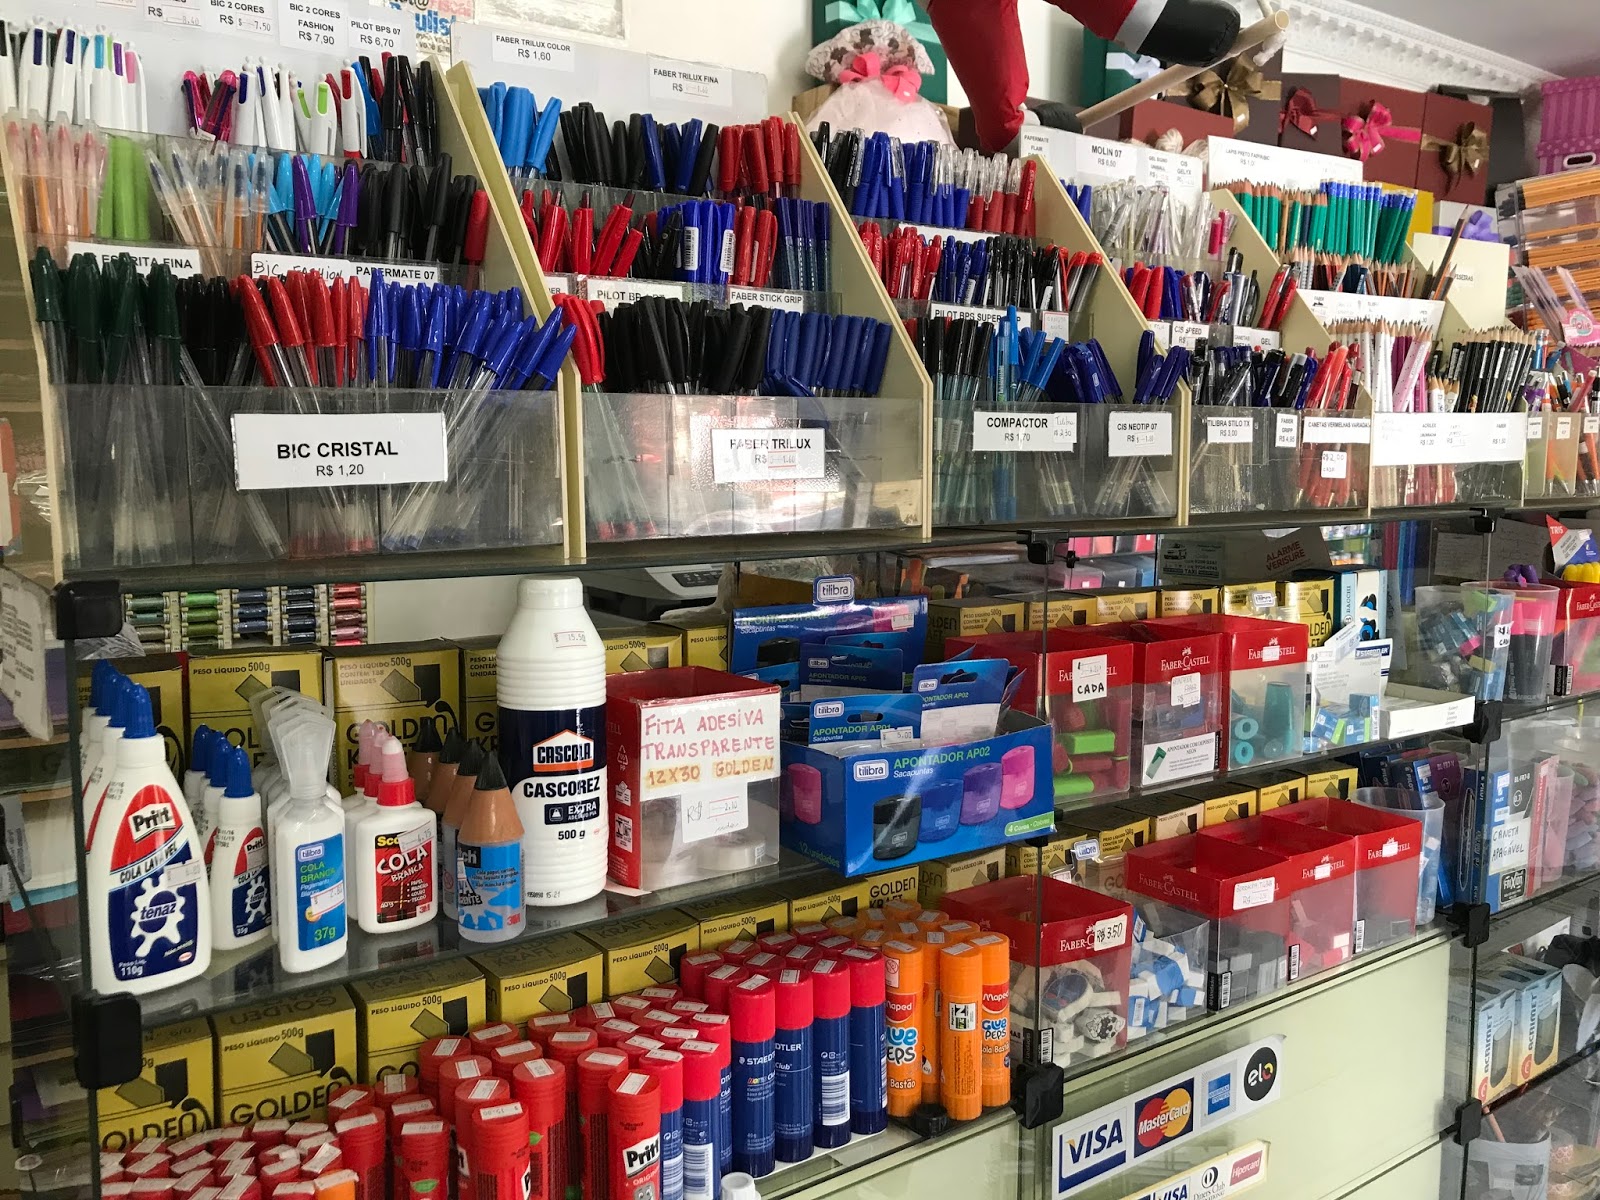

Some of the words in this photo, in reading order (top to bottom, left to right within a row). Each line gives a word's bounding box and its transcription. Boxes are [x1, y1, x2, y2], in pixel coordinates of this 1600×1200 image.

[210, 0, 225, 8] BIC
[227, 1, 233, 9] 2
[234, 2, 265, 14] CORES
[289, 3, 304, 12] BIC
[306, 6, 311, 14] 2
[312, 7, 341, 19] CORES
[219, 14, 234, 25] R$
[298, 20, 334, 32] FASHION
[351, 21, 373, 31] PILOT
[376, 24, 391, 34] BPS
[298, 31, 312, 41] R$
[360, 34, 373, 45] R$
[495, 35, 520, 45] FABER
[521, 39, 545, 48] TRILUX
[547, 43, 571, 52] COLOR
[517, 48, 530, 60] R$
[653, 68, 677, 79] FABER
[678, 71, 702, 82] TRILUX
[704, 75, 719, 84] FINA
[672, 83, 683, 93] R$
[1091, 145, 1113, 157] MOLIN
[1114, 149, 1122, 158] 07
[163, 257, 193, 269] FINA
[423, 271, 435, 280] 07
[597, 290, 626, 301] PILOT
[731, 291, 758, 301] FABER
[760, 293, 784, 303] STICK
[784, 295, 803, 304] GRIP
[960, 311, 975, 321] BPS
[977, 313, 1001, 323] SUPER
[986, 417, 1048, 428] COMPACTOR
[1151, 422, 1157, 430] 07
[772, 438, 811, 449] TRILUX
[1004, 433, 1014, 441] R$
[277, 443, 310, 459] BIC
[317, 441, 398, 458] CRISTAL
[316, 465, 334, 477] R$
[338, 464, 364, 477] 1,20
[1266, 541, 1301, 563] ALARME
[1266, 549, 1306, 571] VERISURE
[822, 584, 849, 595] tilibra
[629, 640, 646, 650] 500g
[214, 665, 247, 674] LÍQUIDO
[248, 661, 271, 673] 500g
[390, 656, 412, 668] 500g
[1161, 655, 1210, 671] FABER-CASTELL
[1077, 682, 1105, 694] CADA
[818, 705, 839, 715] tilibra
[813, 725, 868, 736] APONTADOR
[537, 742, 591, 764] CASCOLA
[641, 736, 775, 760] TRANSPARENTE
[894, 750, 964, 769] APONTADOR
[967, 746, 990, 760] AP02
[715, 757, 774, 777] GOLDEN
[859, 765, 884, 778] tilibra
[893, 768, 934, 778] Sacapuntas
[523, 776, 600, 798] CASCOREZ
[568, 801, 597, 815] EXTRA
[558, 829, 576, 840] 500
[579, 829, 586, 840] g
[1493, 826, 1519, 841] CANETA
[302, 849, 322, 858] tilibra
[377, 845, 428, 875] COLA
[301, 861, 325, 873] COLA
[391, 863, 424, 882] BRANCA
[120, 867, 142, 884] COLA
[301, 869, 335, 883] BRANCA
[870, 879, 917, 898] GOLDEN
[1139, 873, 1199, 901] FABER-CASTELL
[828, 894, 841, 904] 500g
[140, 902, 176, 920] tenaz
[419, 904, 430, 914] 3M
[703, 927, 717, 935] PESO
[718, 922, 741, 932] LÍQUIDO
[741, 916, 756, 927] 500g
[314, 927, 336, 942] 37g
[612, 956, 628, 964] PESO
[629, 950, 653, 961] LÍQUIDO
[653, 942, 669, 955] 500g
[121, 965, 143, 977] 110g
[522, 978, 549, 989] LÍQUIDO
[550, 970, 567, 982] 500g
[391, 1001, 421, 1012] LÍQUIDO
[422, 995, 442, 1006] 500g
[224, 1043, 244, 1051] PESO
[246, 1036, 280, 1047] LÍQUIDO
[281, 1027, 304, 1039] 500g
[1248, 1063, 1273, 1087] elo
[890, 1078, 916, 1088] Bastão
[1138, 1101, 1191, 1136] MasterCard
[1066, 1119, 1123, 1164] VISA
[1232, 1158, 1261, 1178] Hipercard
